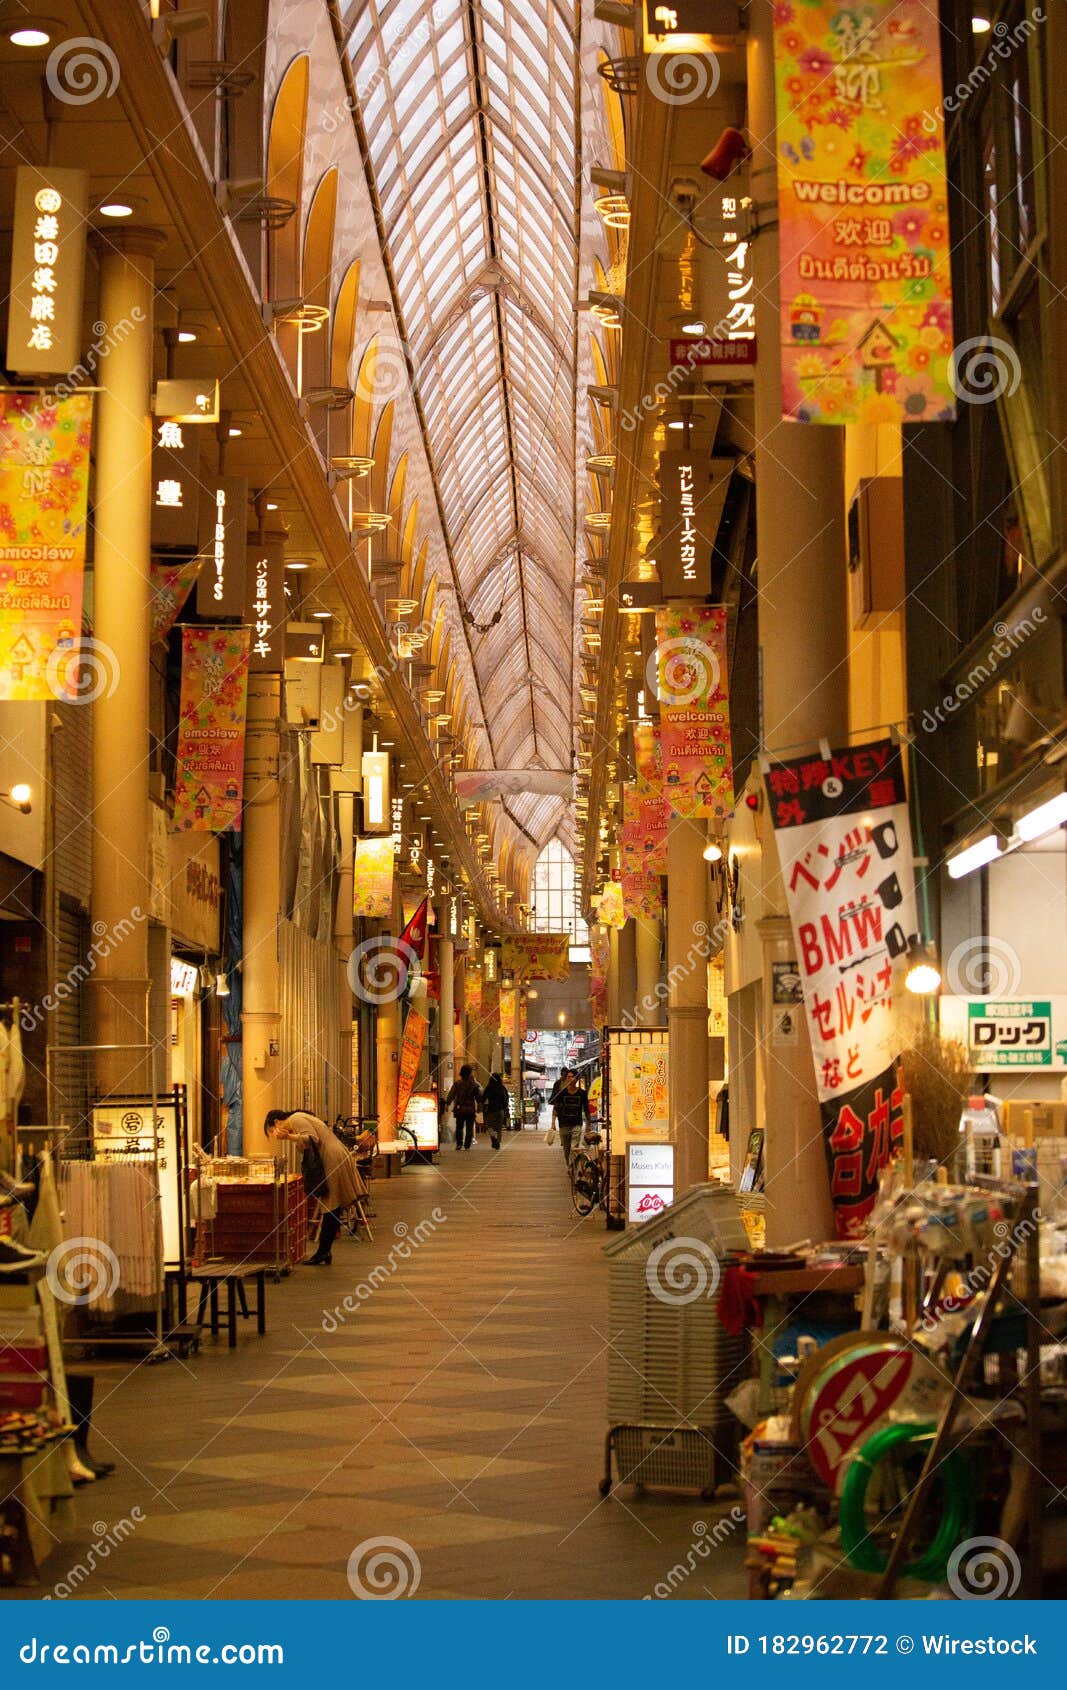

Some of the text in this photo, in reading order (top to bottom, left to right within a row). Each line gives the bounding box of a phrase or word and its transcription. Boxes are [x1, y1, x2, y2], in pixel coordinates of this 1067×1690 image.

[794, 180, 930, 204] welcome
[834, 218, 892, 245] 欢迎
[800, 252, 931, 280] ยินดีต้อนรับ
[725, 242, 755, 340] イシグ
[213, 490, 225, 600] BIBBY'S
[252, 600, 271, 658] ササキ
[668, 712, 724, 723] welcome
[789, 827, 872, 892] ベンツ
[798, 893, 884, 977] BMW
[974, 1022, 1046, 1045] ロック
[822, 1043, 863, 1089] など
